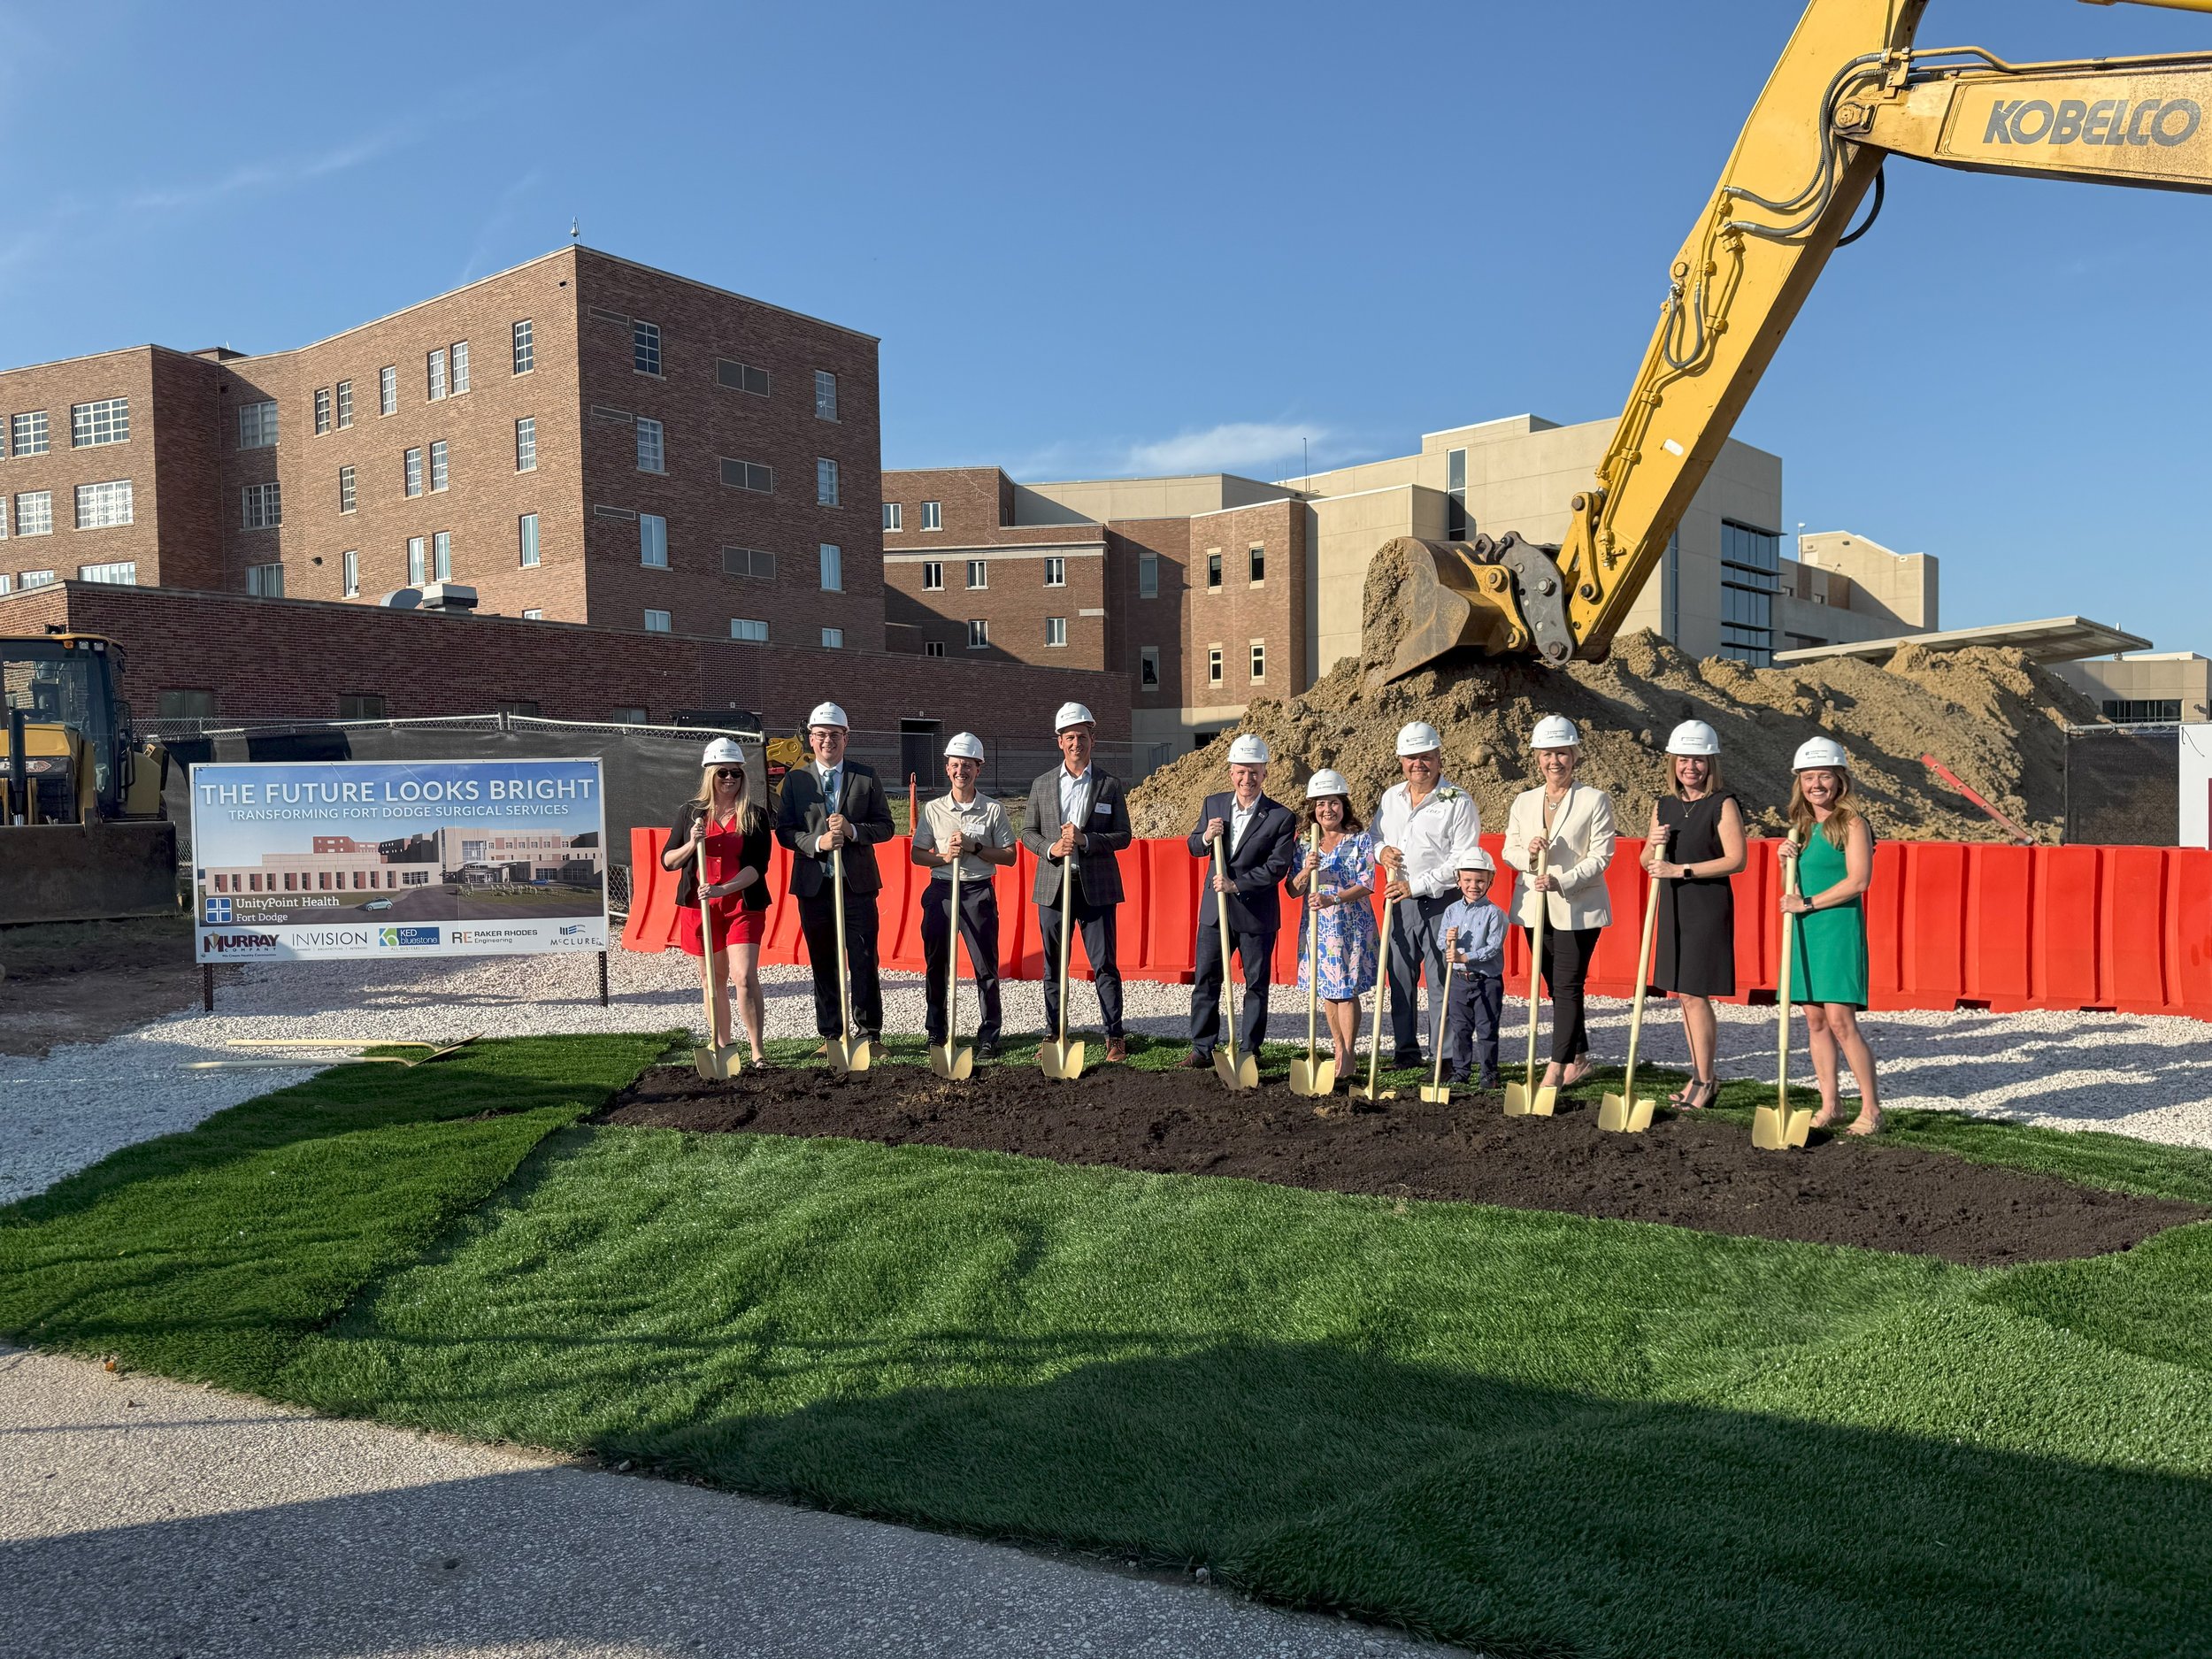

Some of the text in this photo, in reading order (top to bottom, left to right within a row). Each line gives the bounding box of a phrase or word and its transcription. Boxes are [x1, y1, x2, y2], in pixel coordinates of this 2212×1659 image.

[1983, 98, 2201, 147] KOBELCO
[200, 779, 595, 805] THE FUTURE LOOKS BRIGHT
[228, 804, 569, 820] TRANSFORMING FORT DODGE SURGICAL SERVICES
[235, 896, 340, 910] UnityPoint Health
[236, 912, 288, 923] Fort Dodge
[292, 931, 368, 947] INVISION
[400, 928, 418, 937] KED
[451, 931, 473, 944] RE
[204, 933, 280, 953] MURRAY
[400, 936, 438, 945] bluestone
